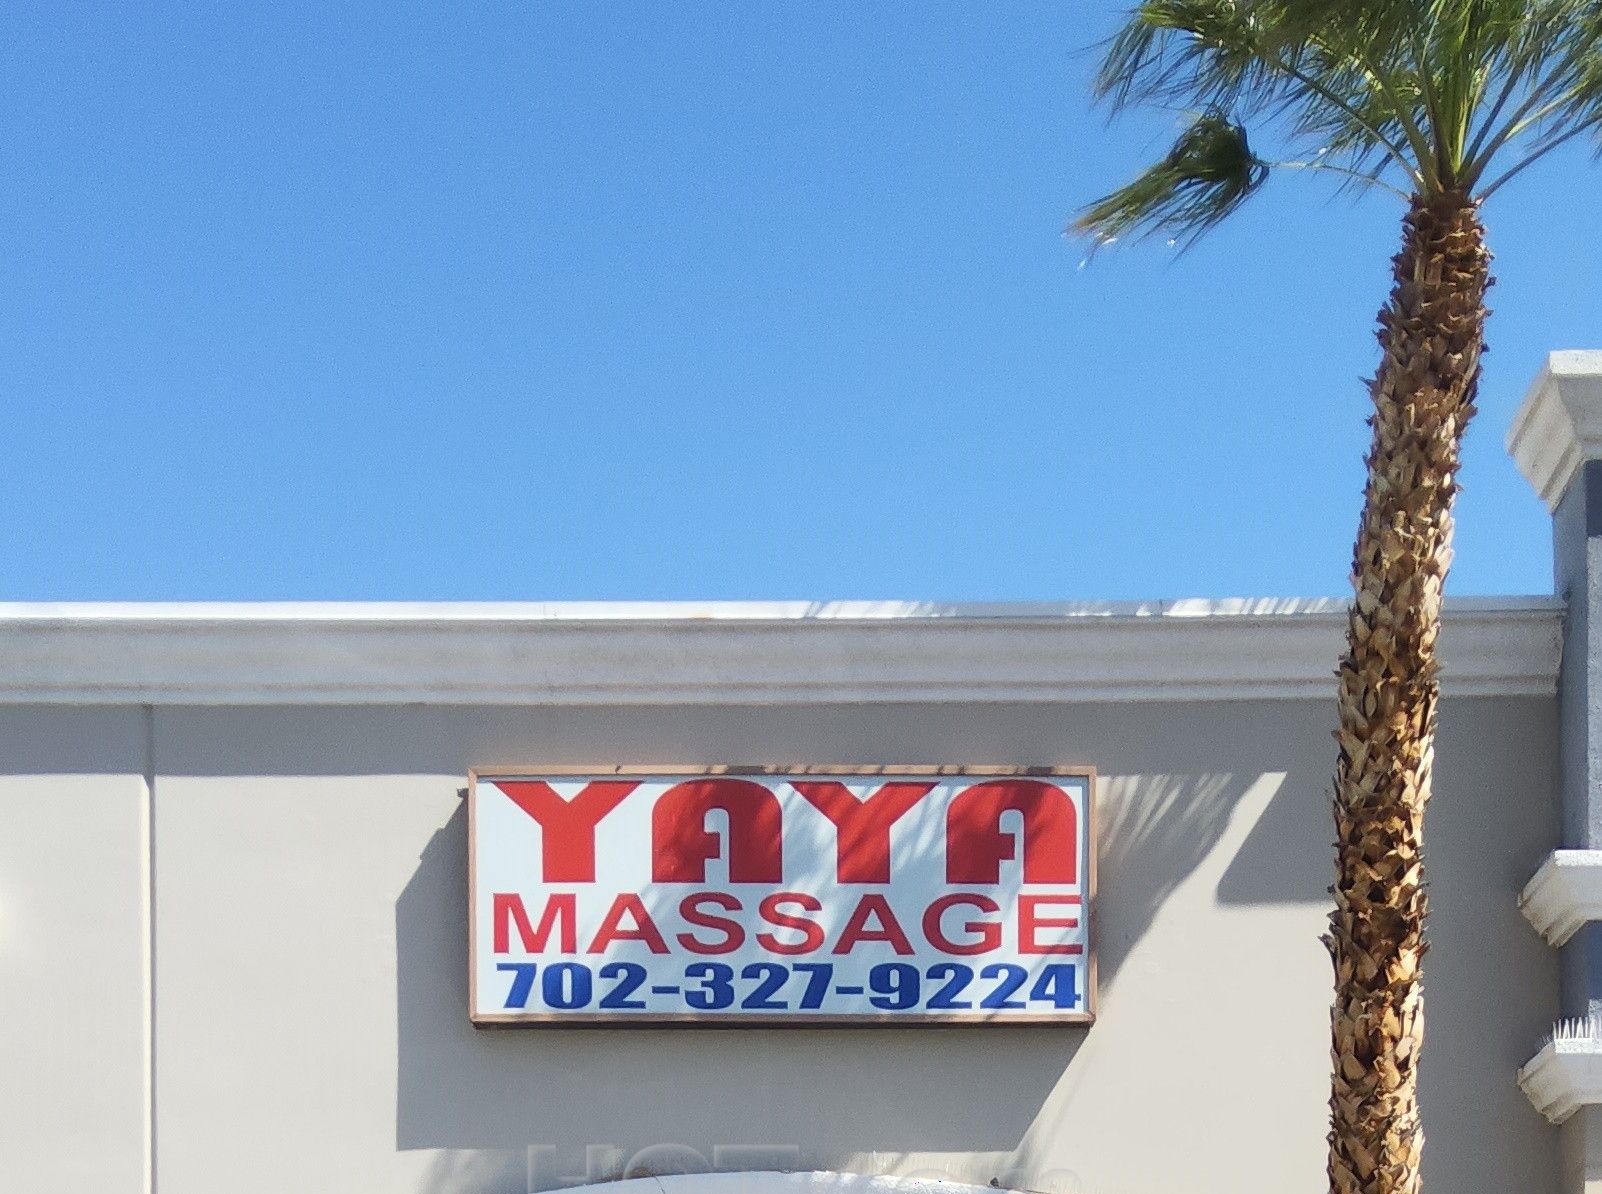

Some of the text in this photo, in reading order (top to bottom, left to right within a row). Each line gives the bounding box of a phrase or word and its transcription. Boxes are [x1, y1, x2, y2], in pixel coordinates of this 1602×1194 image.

[494, 779, 1078, 884] YAYA
[493, 893, 1083, 954] MASSAGE
[496, 963, 1081, 1010] 702-327-9224
